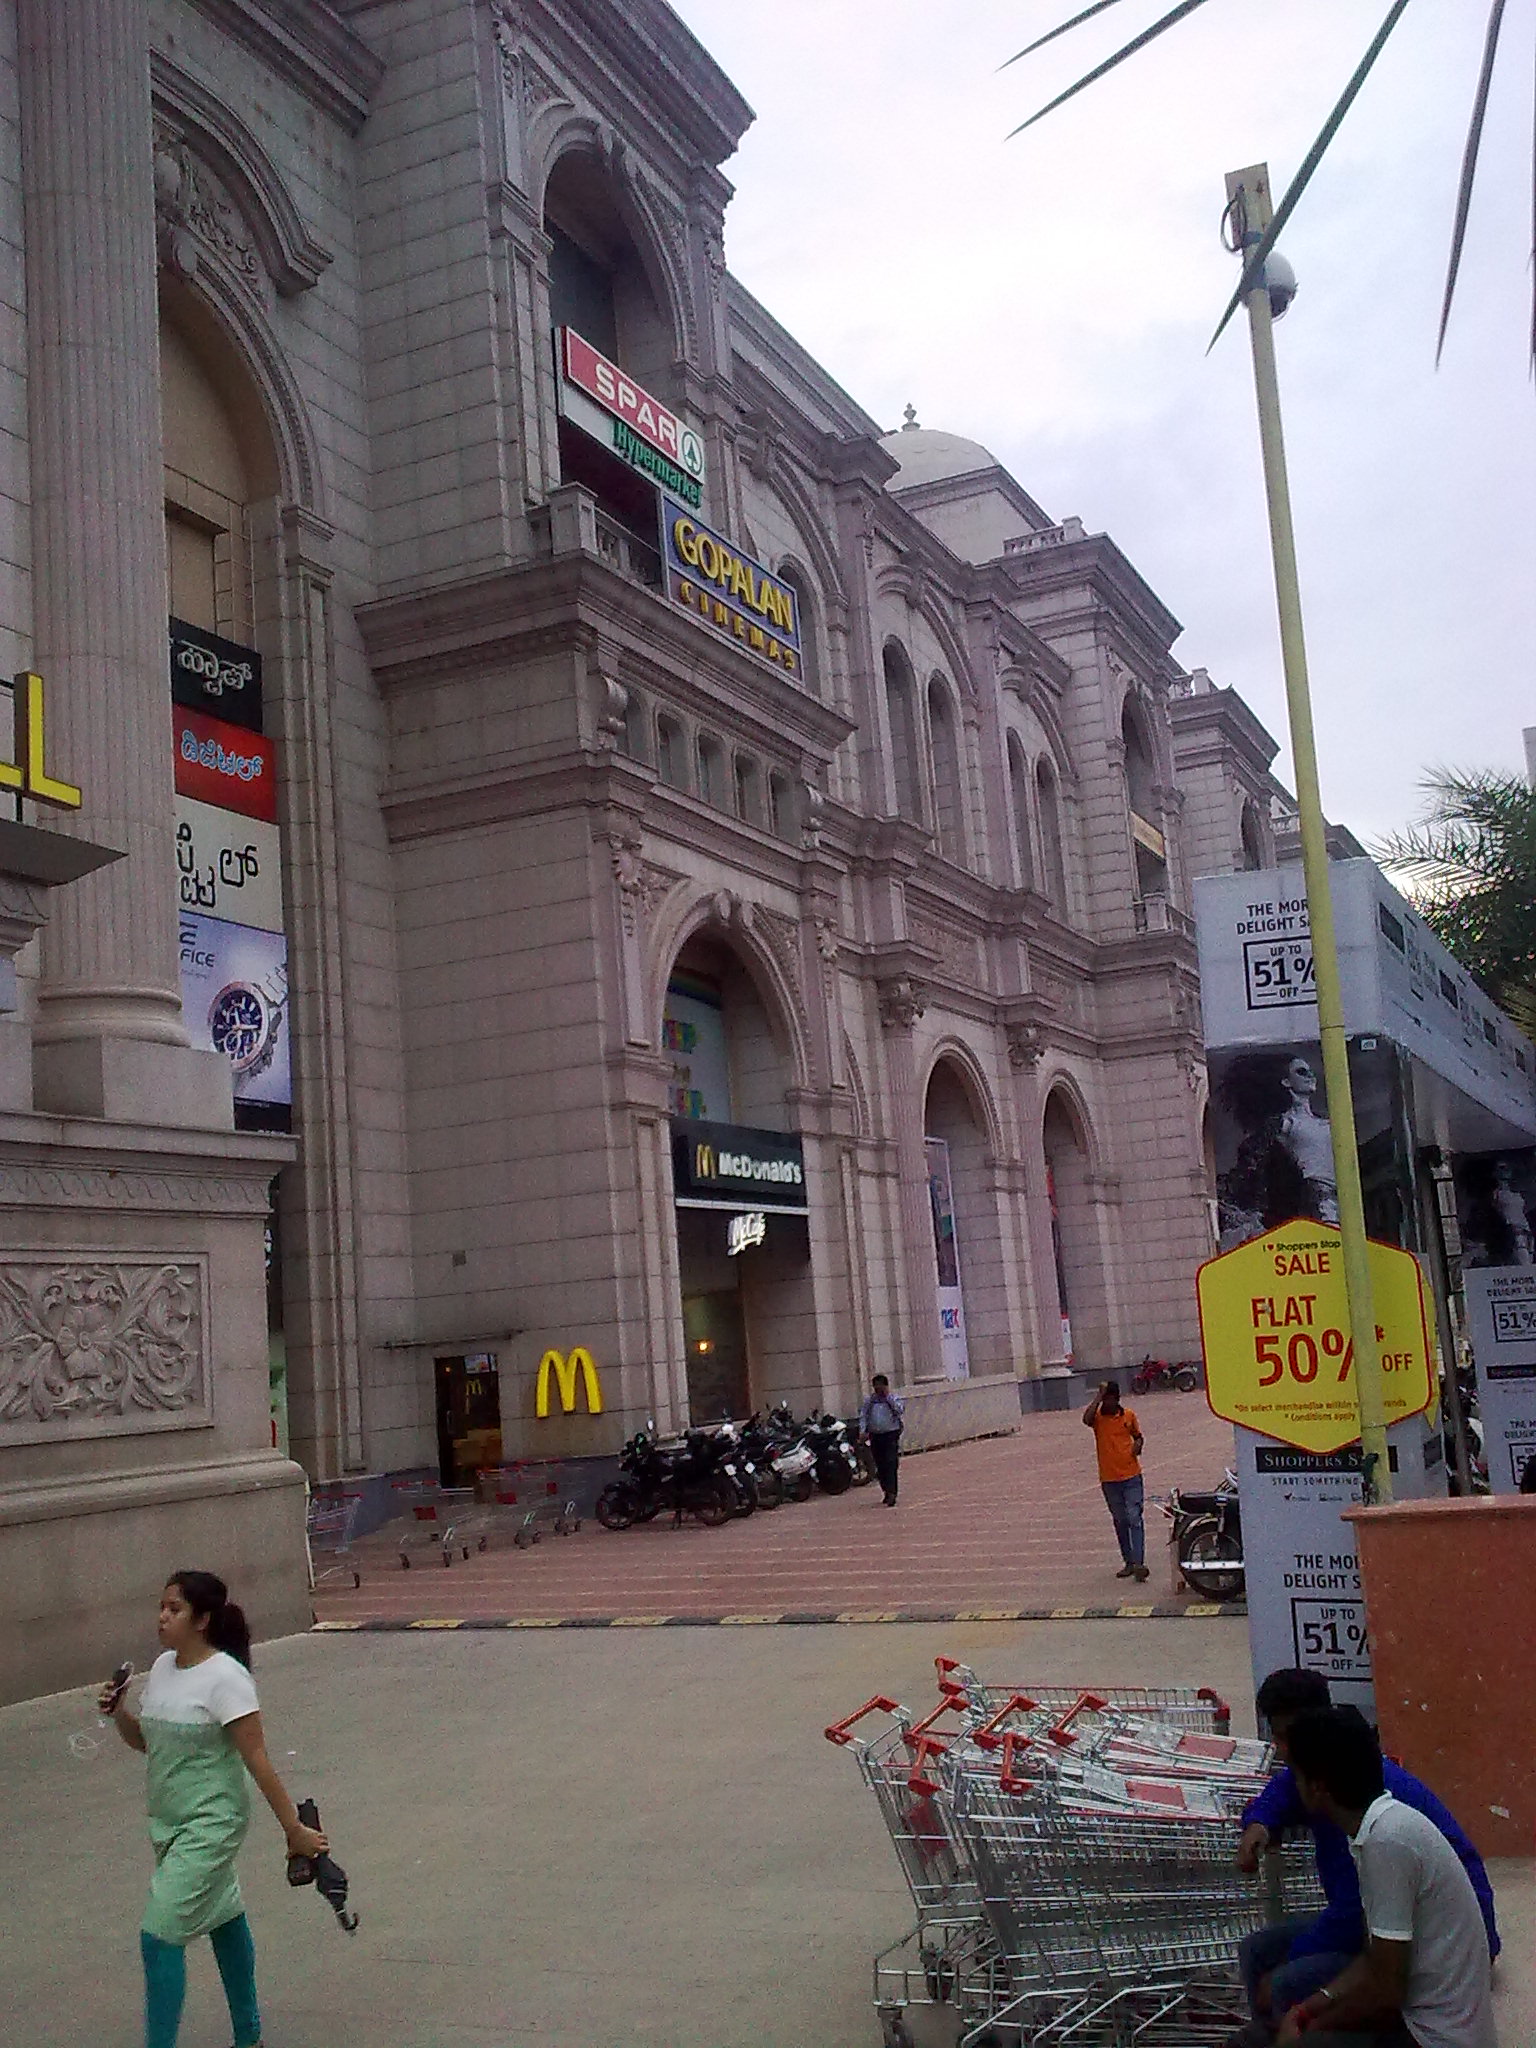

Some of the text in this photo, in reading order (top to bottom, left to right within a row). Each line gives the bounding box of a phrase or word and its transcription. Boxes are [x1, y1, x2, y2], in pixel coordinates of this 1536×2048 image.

[595, 363, 679, 453] SPAR
[674, 517, 794, 636] GOPALAN
[679, 580, 797, 670] CINEMAS
[1246, 899, 1308, 917] THE MOR
[1236, 916, 1295, 934] DELIGHT
[180, 948, 216, 968] FICE
[1270, 944, 1302, 957] UP TO
[1253, 957, 1315, 987] 51%
[1279, 986, 1299, 998] OFF
[718, 1152, 802, 1184] McDonald's
[1276, 1241, 1318, 1252] Shoppers
[1320, 1239, 1341, 1250] Stop
[1274, 1252, 1331, 1276] SALE
[1251, 1295, 1317, 1328] FLAT
[1499, 1311, 1536, 1329] 51%
[1254, 1328, 1413, 1388] 50% OFF
[1272, 1476, 1299, 1486] START
[1294, 1554, 1360, 1570] THE MO
[1284, 1573, 1347, 1589] DELIGHT
[1321, 1608, 1356, 1620] UP TO
[1303, 1622, 1370, 1656] 51%
[1331, 1658, 1354, 1670] OFF
